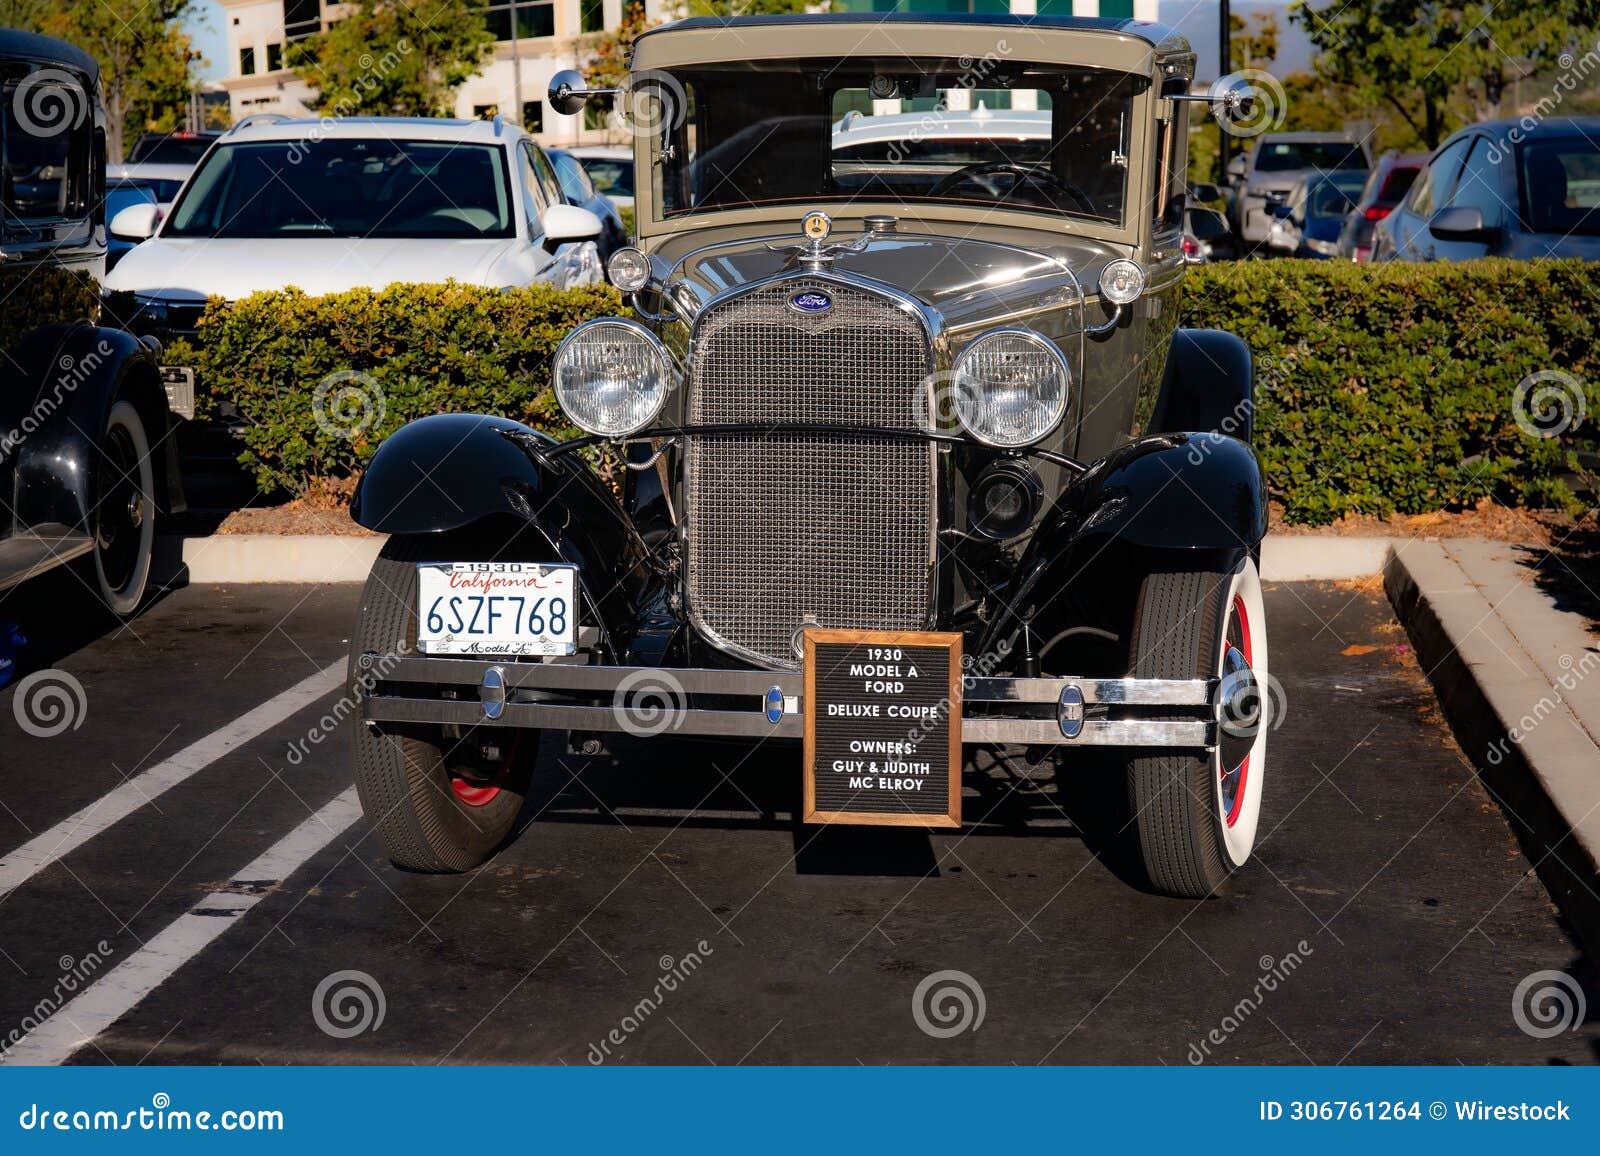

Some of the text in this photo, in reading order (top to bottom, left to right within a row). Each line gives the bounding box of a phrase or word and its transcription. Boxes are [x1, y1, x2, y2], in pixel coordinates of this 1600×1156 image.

[798, 294, 827, 306] Ford
[450, 572, 548, 594] California
[427, 596, 566, 635] 6SZF768
[461, 642, 510, 653] Model
[867, 649, 902, 661] 1930
[850, 665, 918, 678] MODEL A
[865, 681, 904, 693] FORD
[828, 704, 937, 718] DELUXE COUPE
[850, 741, 917, 755] OWNERS:
[832, 760, 929, 775] GUY & JUDITH
[849, 777, 923, 791] MC ELROY
